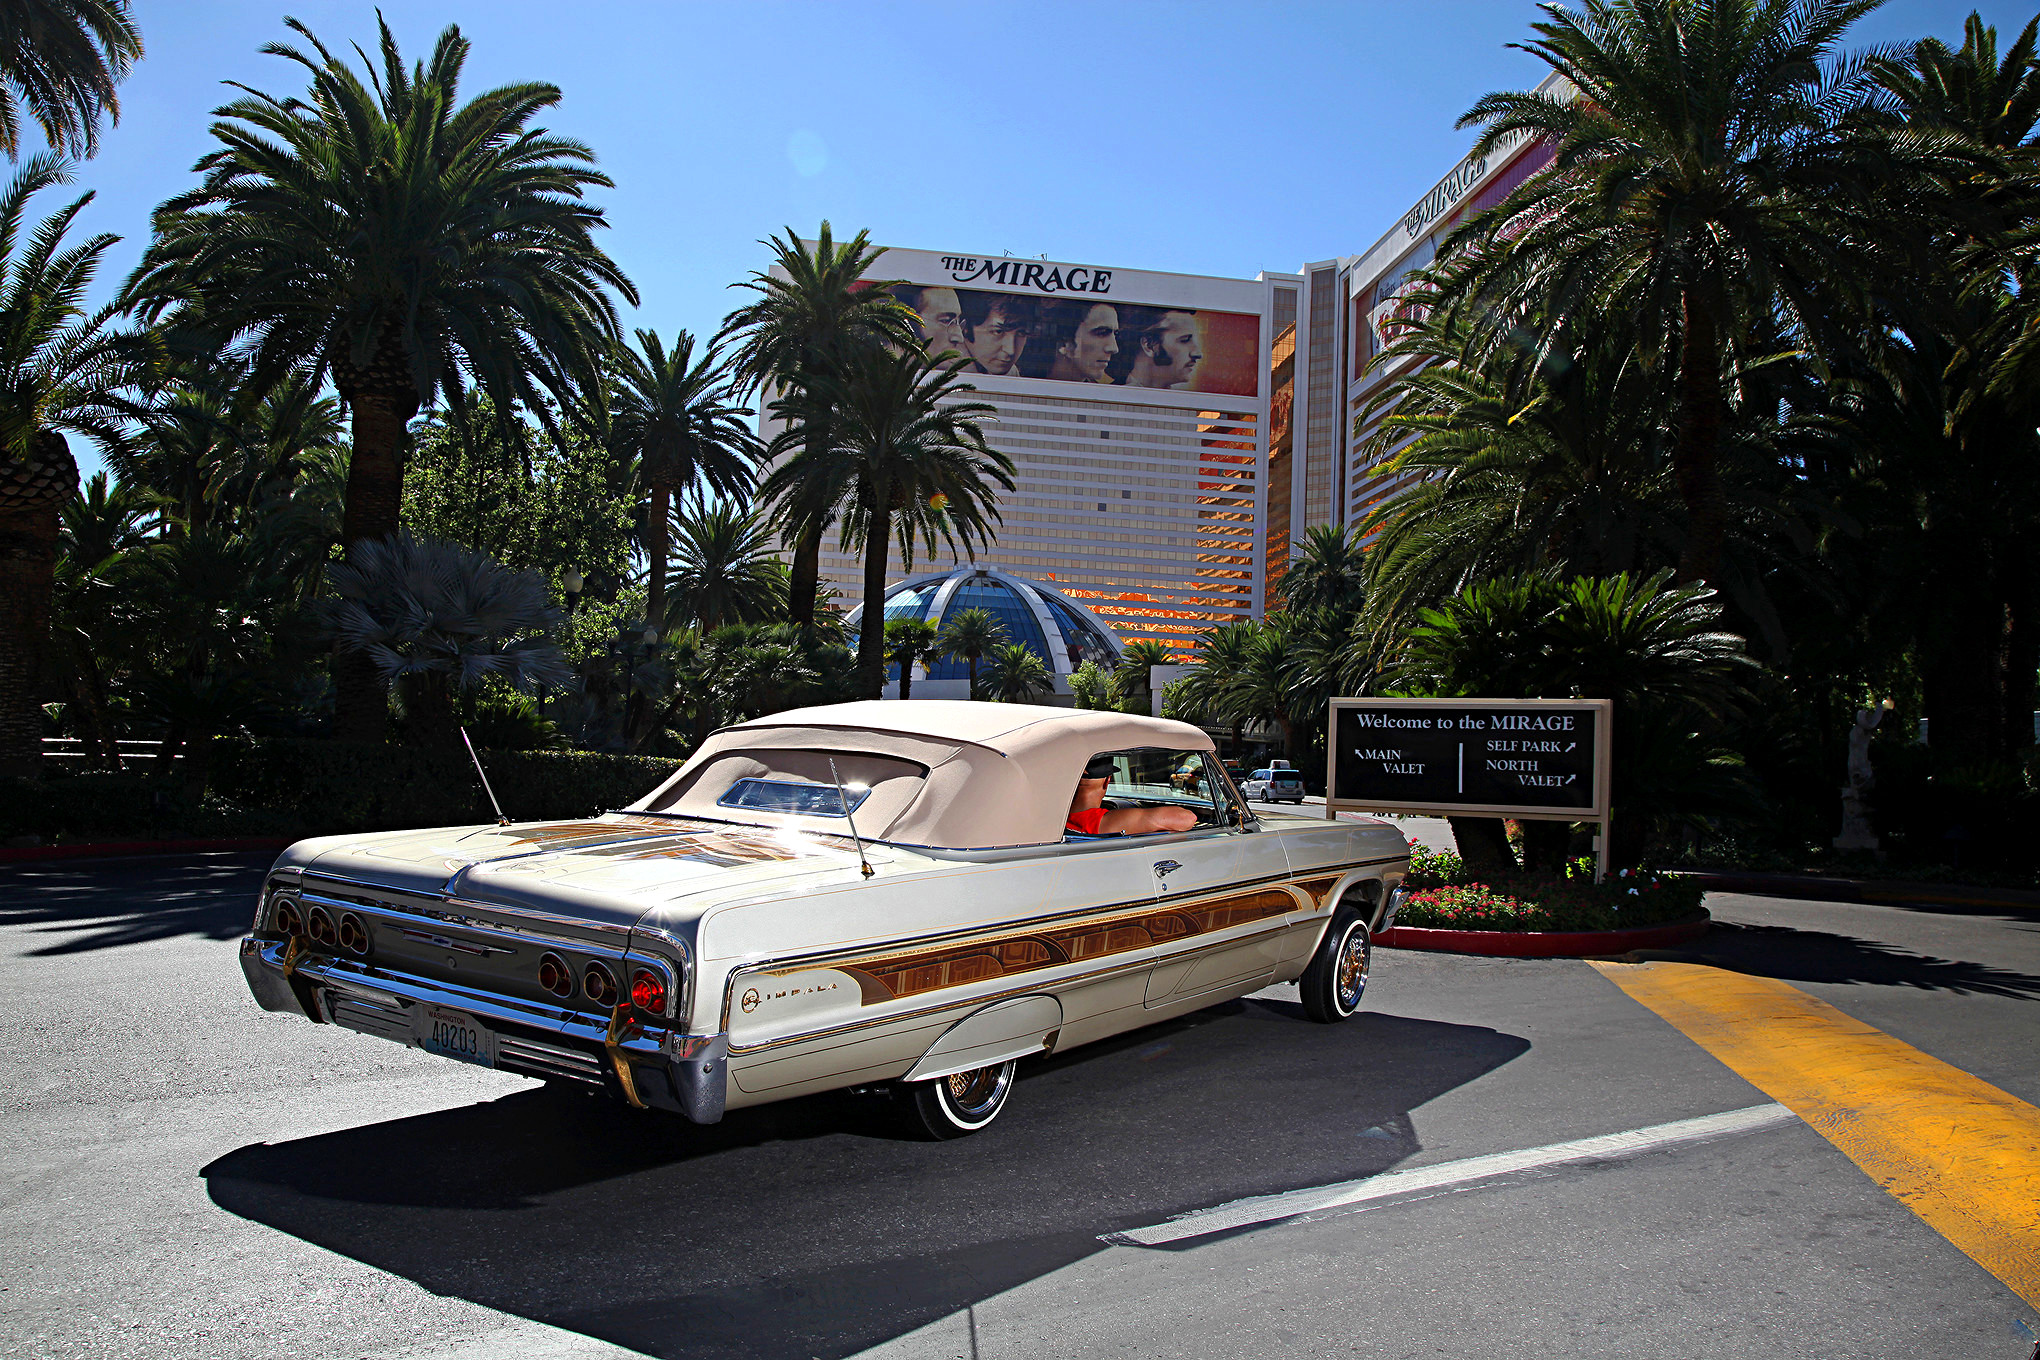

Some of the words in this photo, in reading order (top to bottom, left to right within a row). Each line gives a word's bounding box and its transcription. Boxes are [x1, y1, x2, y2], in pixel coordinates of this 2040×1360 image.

[941, 256, 977, 272] THE
[952, 260, 1112, 293] MIRAGE
[1357, 713, 1431, 729] Welcome
[1437, 716, 1453, 729] to
[1459, 714, 1485, 730] the
[1490, 715, 1575, 731] MIRAGE
[1486, 740, 1520, 752] SELF
[1522, 741, 1560, 753] PARK
[1365, 749, 1401, 761] MAIN
[1383, 763, 1425, 775] VALET
[1486, 759, 1538, 772] NORTH
[1518, 775, 1565, 787] VALET
[428, 1010, 466, 1025] WASHINGTON
[433, 1021, 477, 1055] 40203
